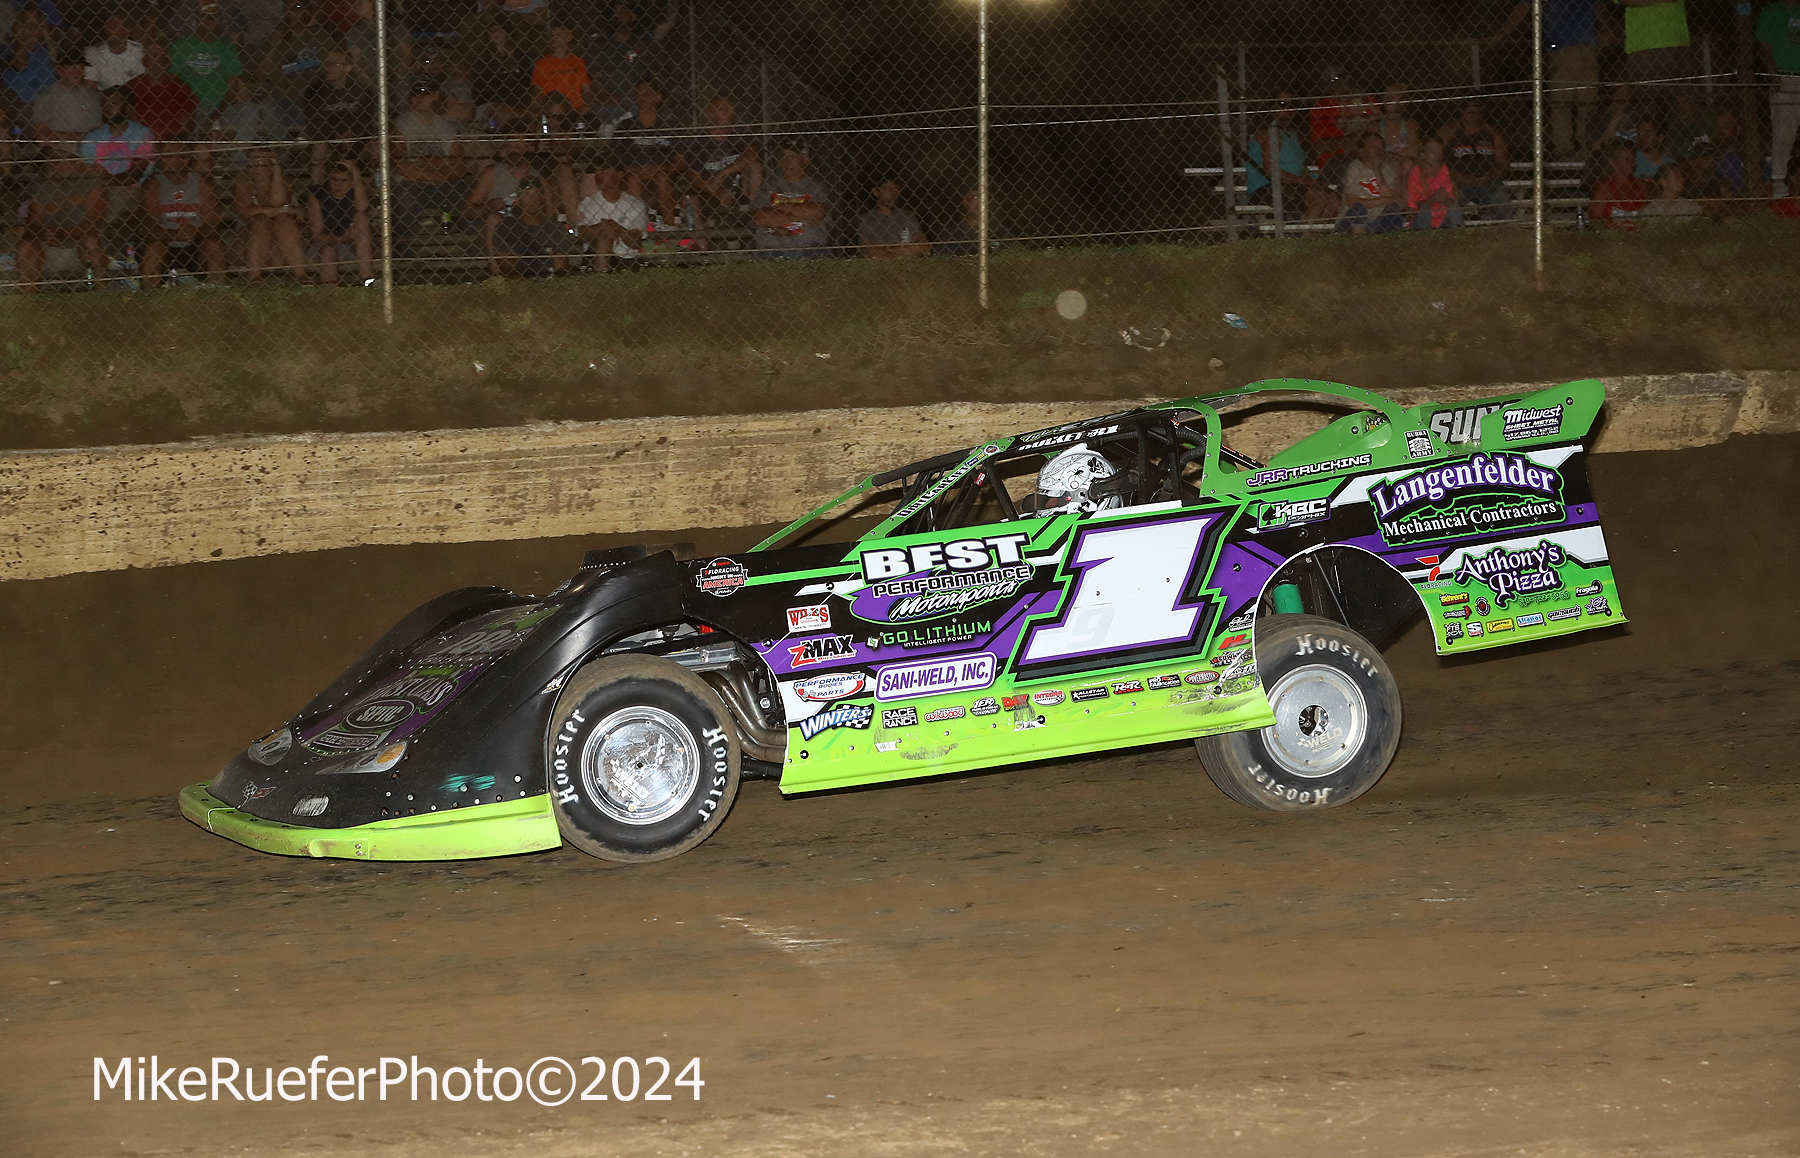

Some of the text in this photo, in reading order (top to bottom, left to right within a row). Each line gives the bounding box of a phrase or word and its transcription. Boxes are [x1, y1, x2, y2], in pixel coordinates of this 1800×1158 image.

[1504, 404, 1562, 424] Midwest
[1411, 449, 1432, 458] ARMY
[1373, 455, 1555, 517] Langenfelder
[1274, 498, 1327, 518] KBC
[1383, 501, 1557, 537] Mechanical Contractors
[708, 566, 740, 575] FLORACING
[862, 533, 1028, 581] BEST
[1456, 542, 1561, 581] Anthony's
[703, 577, 743, 589] AMERICA
[873, 566, 1032, 598] PERFORMANCE
[1022, 514, 1216, 663] 1
[1420, 580, 1453, 590] FLORACING
[1489, 569, 1558, 606] Pizza
[890, 579, 1020, 620] Motorsports
[882, 620, 992, 645] GO LITHIUM
[904, 634, 973, 648] INTELLIGENT POWER
[1294, 633, 1379, 678] Hoosier
[795, 673, 864, 688] PERFORMANCE
[881, 660, 990, 692] SANI-WELD, INC.
[407, 677, 453, 706] CLASS
[816, 688, 845, 697] PARTS
[356, 705, 405, 722] SEPTIC
[800, 706, 872, 740] WINTERS
[882, 707, 916, 719] RACE
[883, 716, 918, 728] RANCH
[1308, 726, 1343, 748] WELD
[554, 708, 586, 805] Hoosier
[698, 725, 729, 821] Hoosier
[1248, 764, 1333, 806] Hoosier
